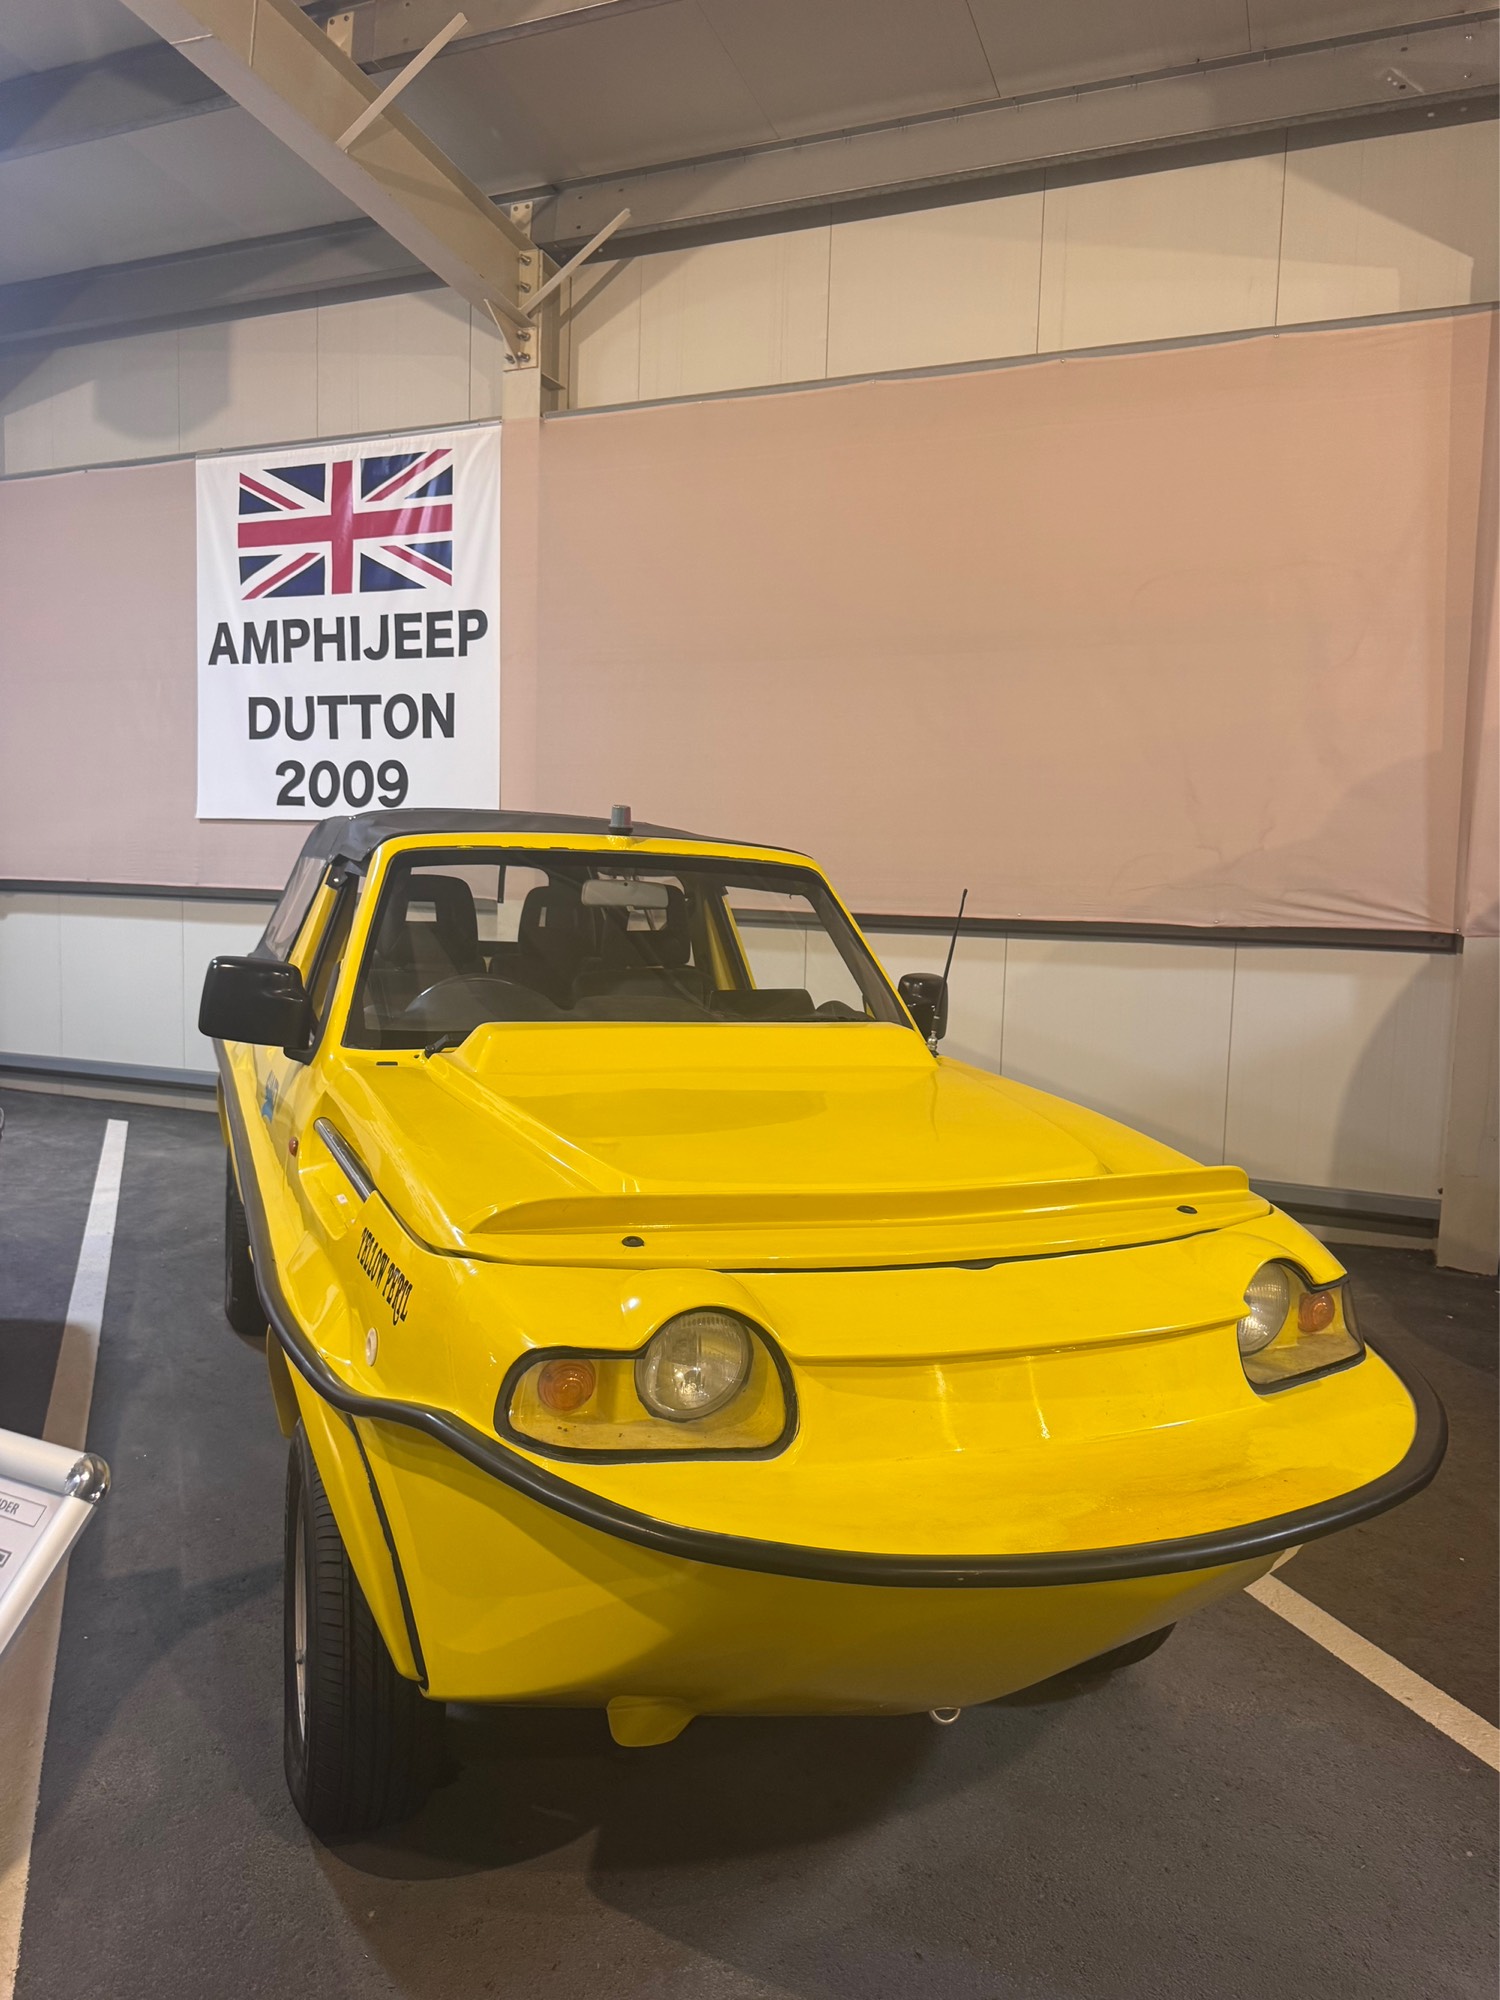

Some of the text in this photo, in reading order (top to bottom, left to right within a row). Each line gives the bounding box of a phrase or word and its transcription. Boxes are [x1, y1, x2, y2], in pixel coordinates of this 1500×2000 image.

[208, 609, 489, 666] AMPHIJEEP
[248, 692, 455, 741] DUTTON
[275, 760, 409, 808] 2009
[356, 1227, 391, 1290] YELLOW
[0, 1498, 20, 1515] DER
